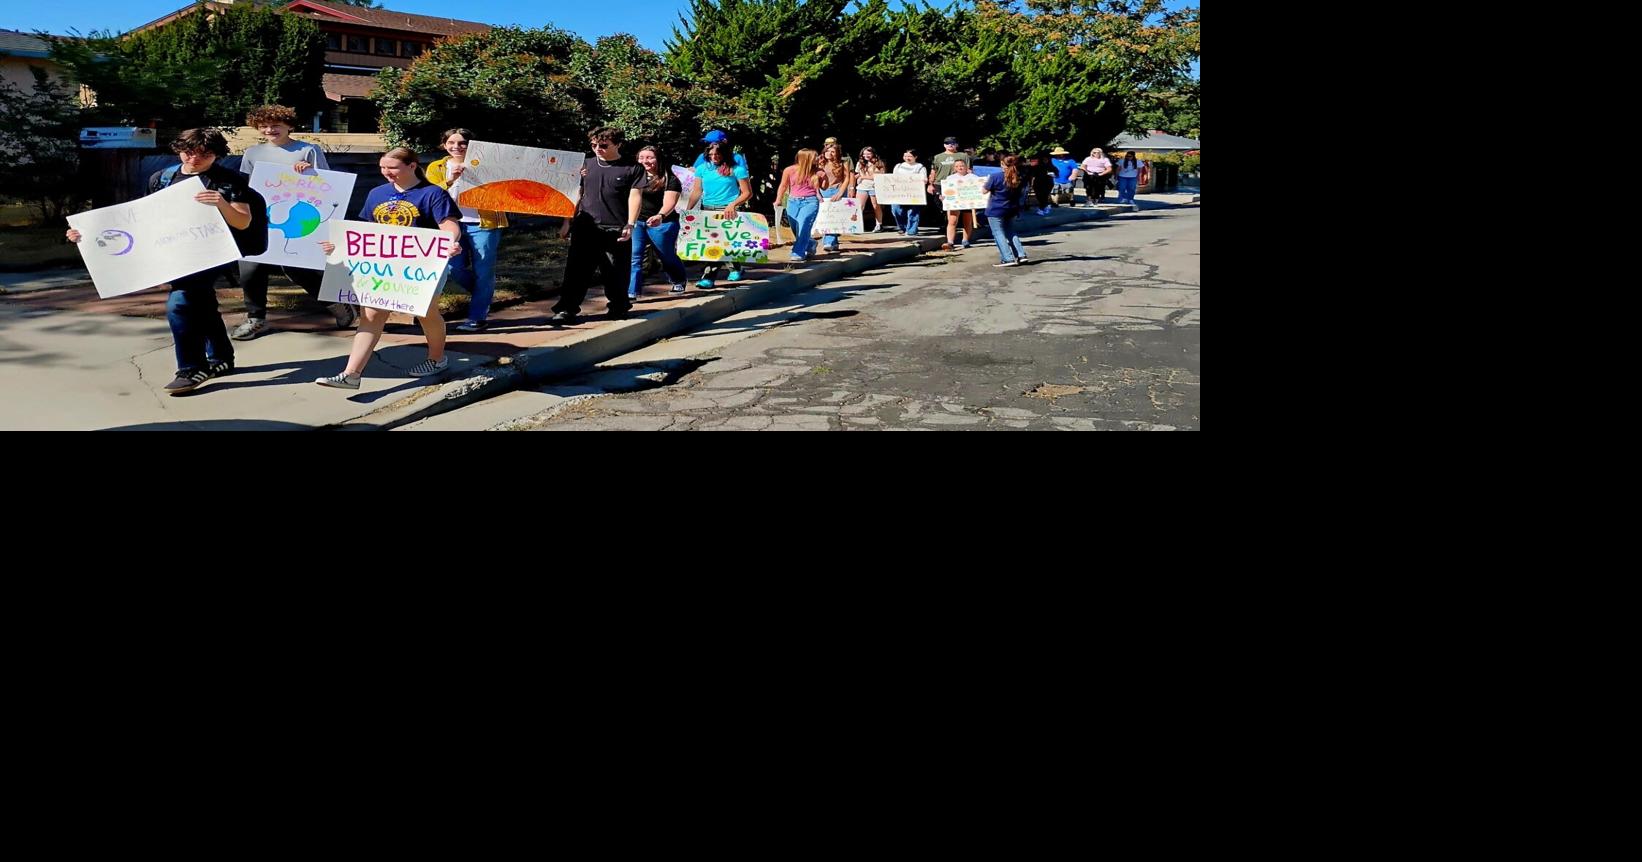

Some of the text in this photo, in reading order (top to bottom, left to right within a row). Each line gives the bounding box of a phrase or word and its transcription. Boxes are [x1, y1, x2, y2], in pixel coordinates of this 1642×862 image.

[704, 216, 744, 229] Let
[346, 231, 450, 259] BELIEVE
[348, 259, 438, 282] you can
